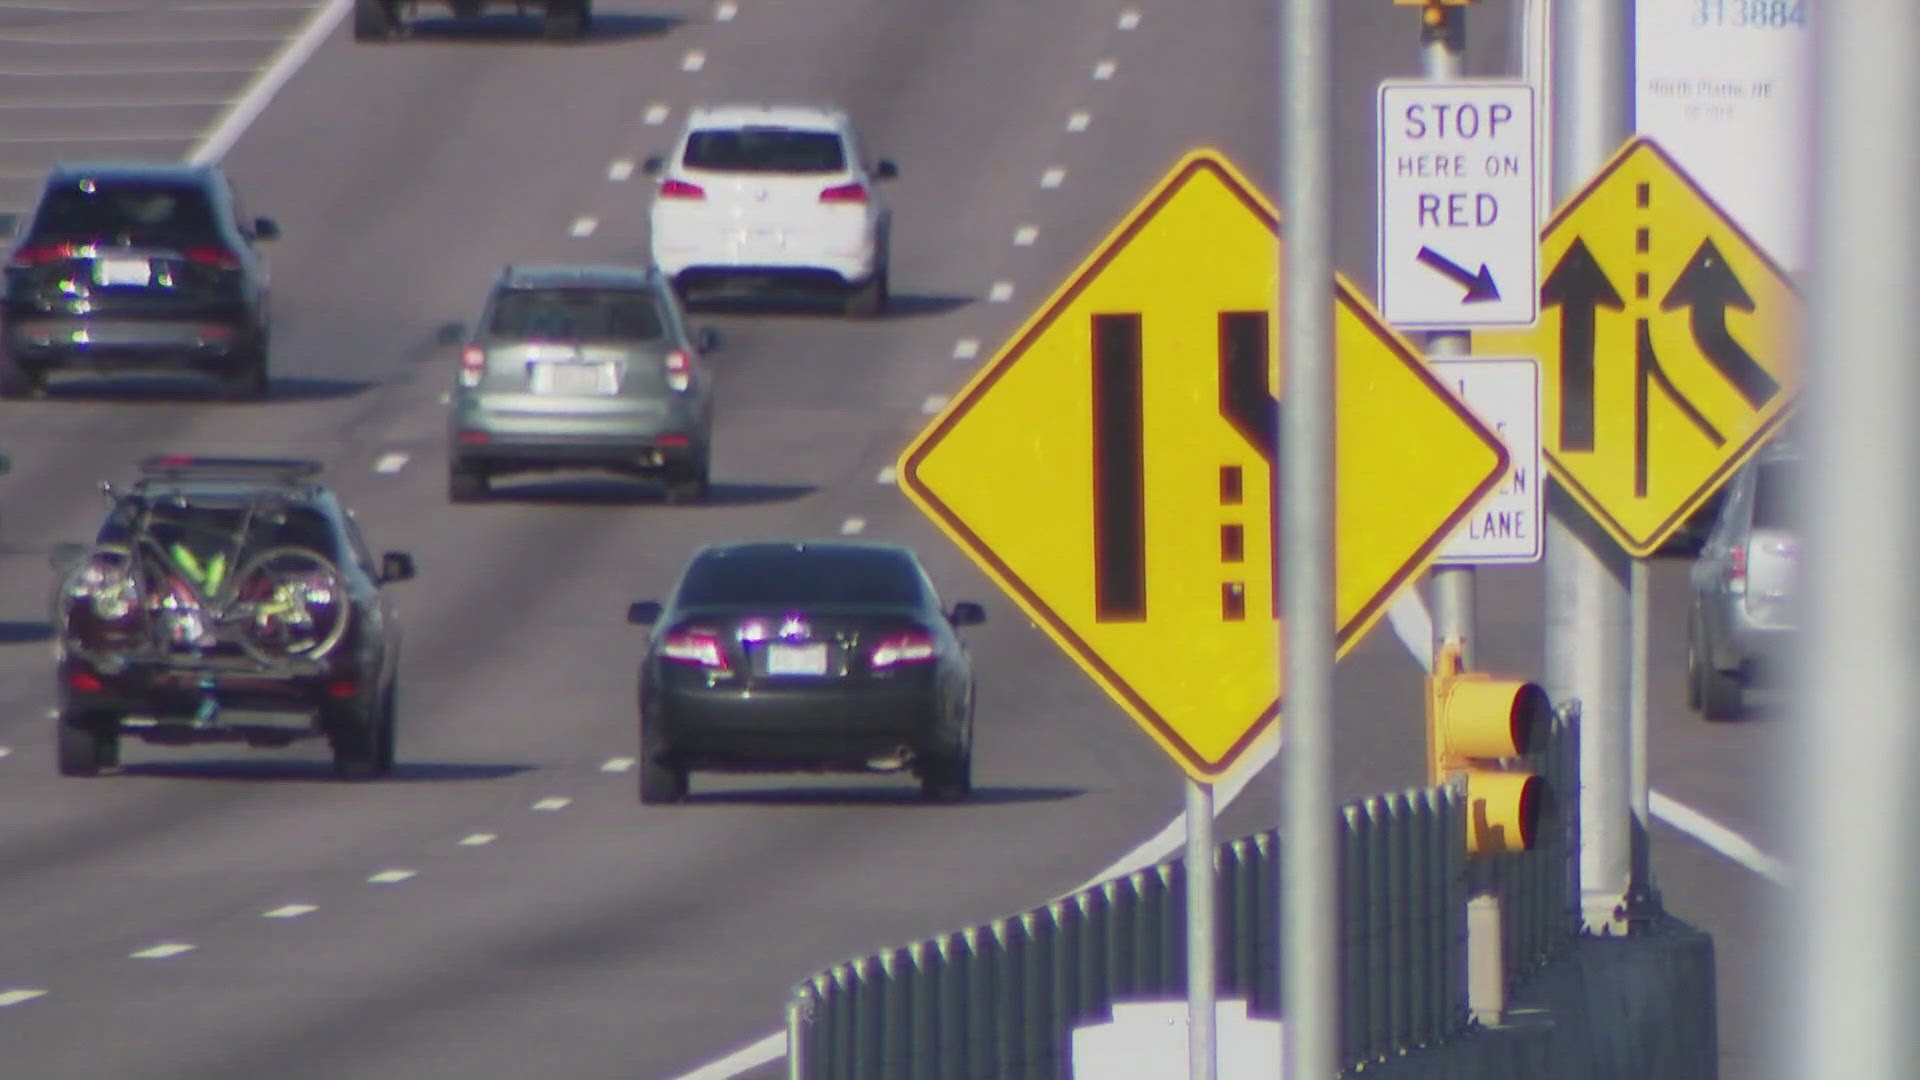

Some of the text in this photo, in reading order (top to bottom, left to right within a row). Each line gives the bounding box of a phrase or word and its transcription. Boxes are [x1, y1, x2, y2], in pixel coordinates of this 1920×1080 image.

[1405, 103, 1512, 139] STOP
[1398, 155, 1519, 177] HERE ON
[1419, 193, 1499, 228] RED
[1469, 511, 1526, 540] LANE
